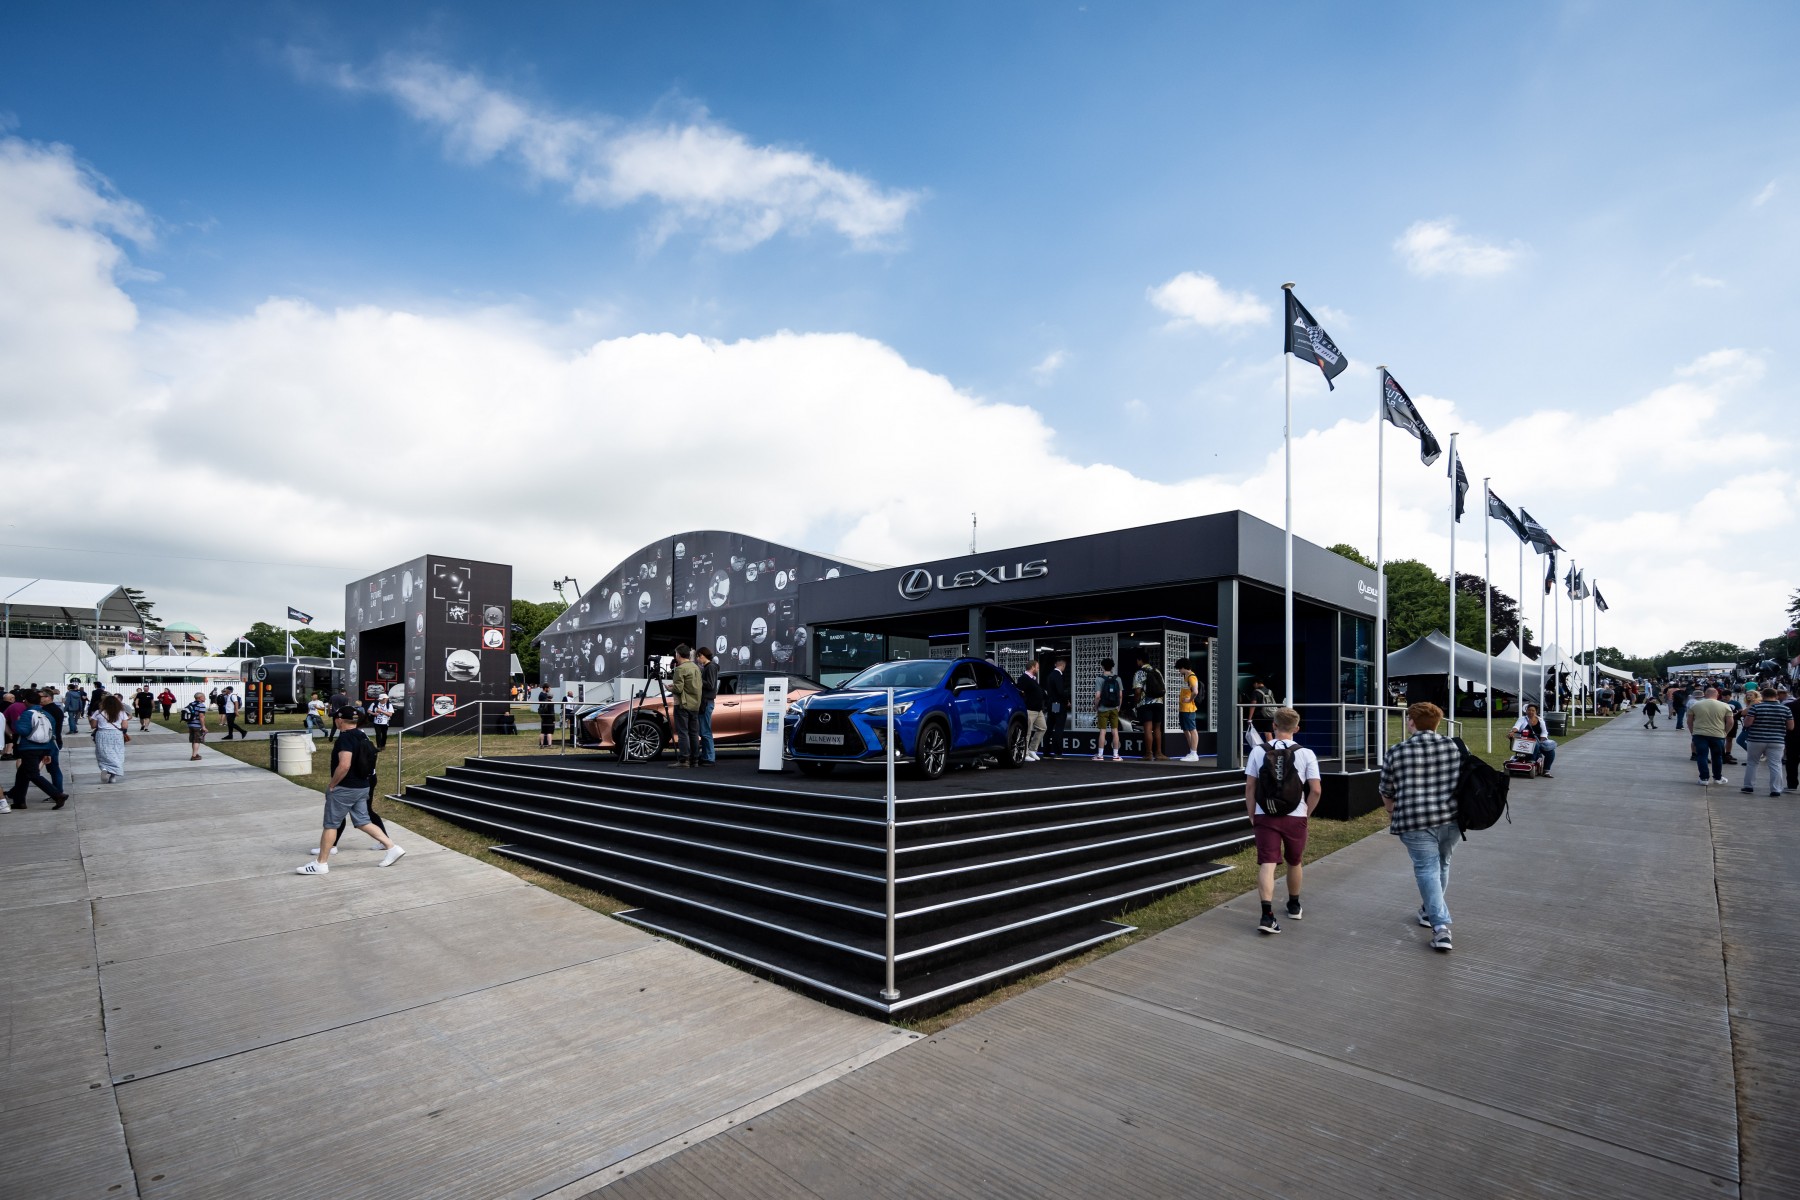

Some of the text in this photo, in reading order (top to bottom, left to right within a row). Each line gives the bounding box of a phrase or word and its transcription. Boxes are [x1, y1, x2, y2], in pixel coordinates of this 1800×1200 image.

[937, 559, 1049, 590] LEXUS
[1364, 584, 1378, 597] LEXU
[1275, 755, 1284, 781] adidas
